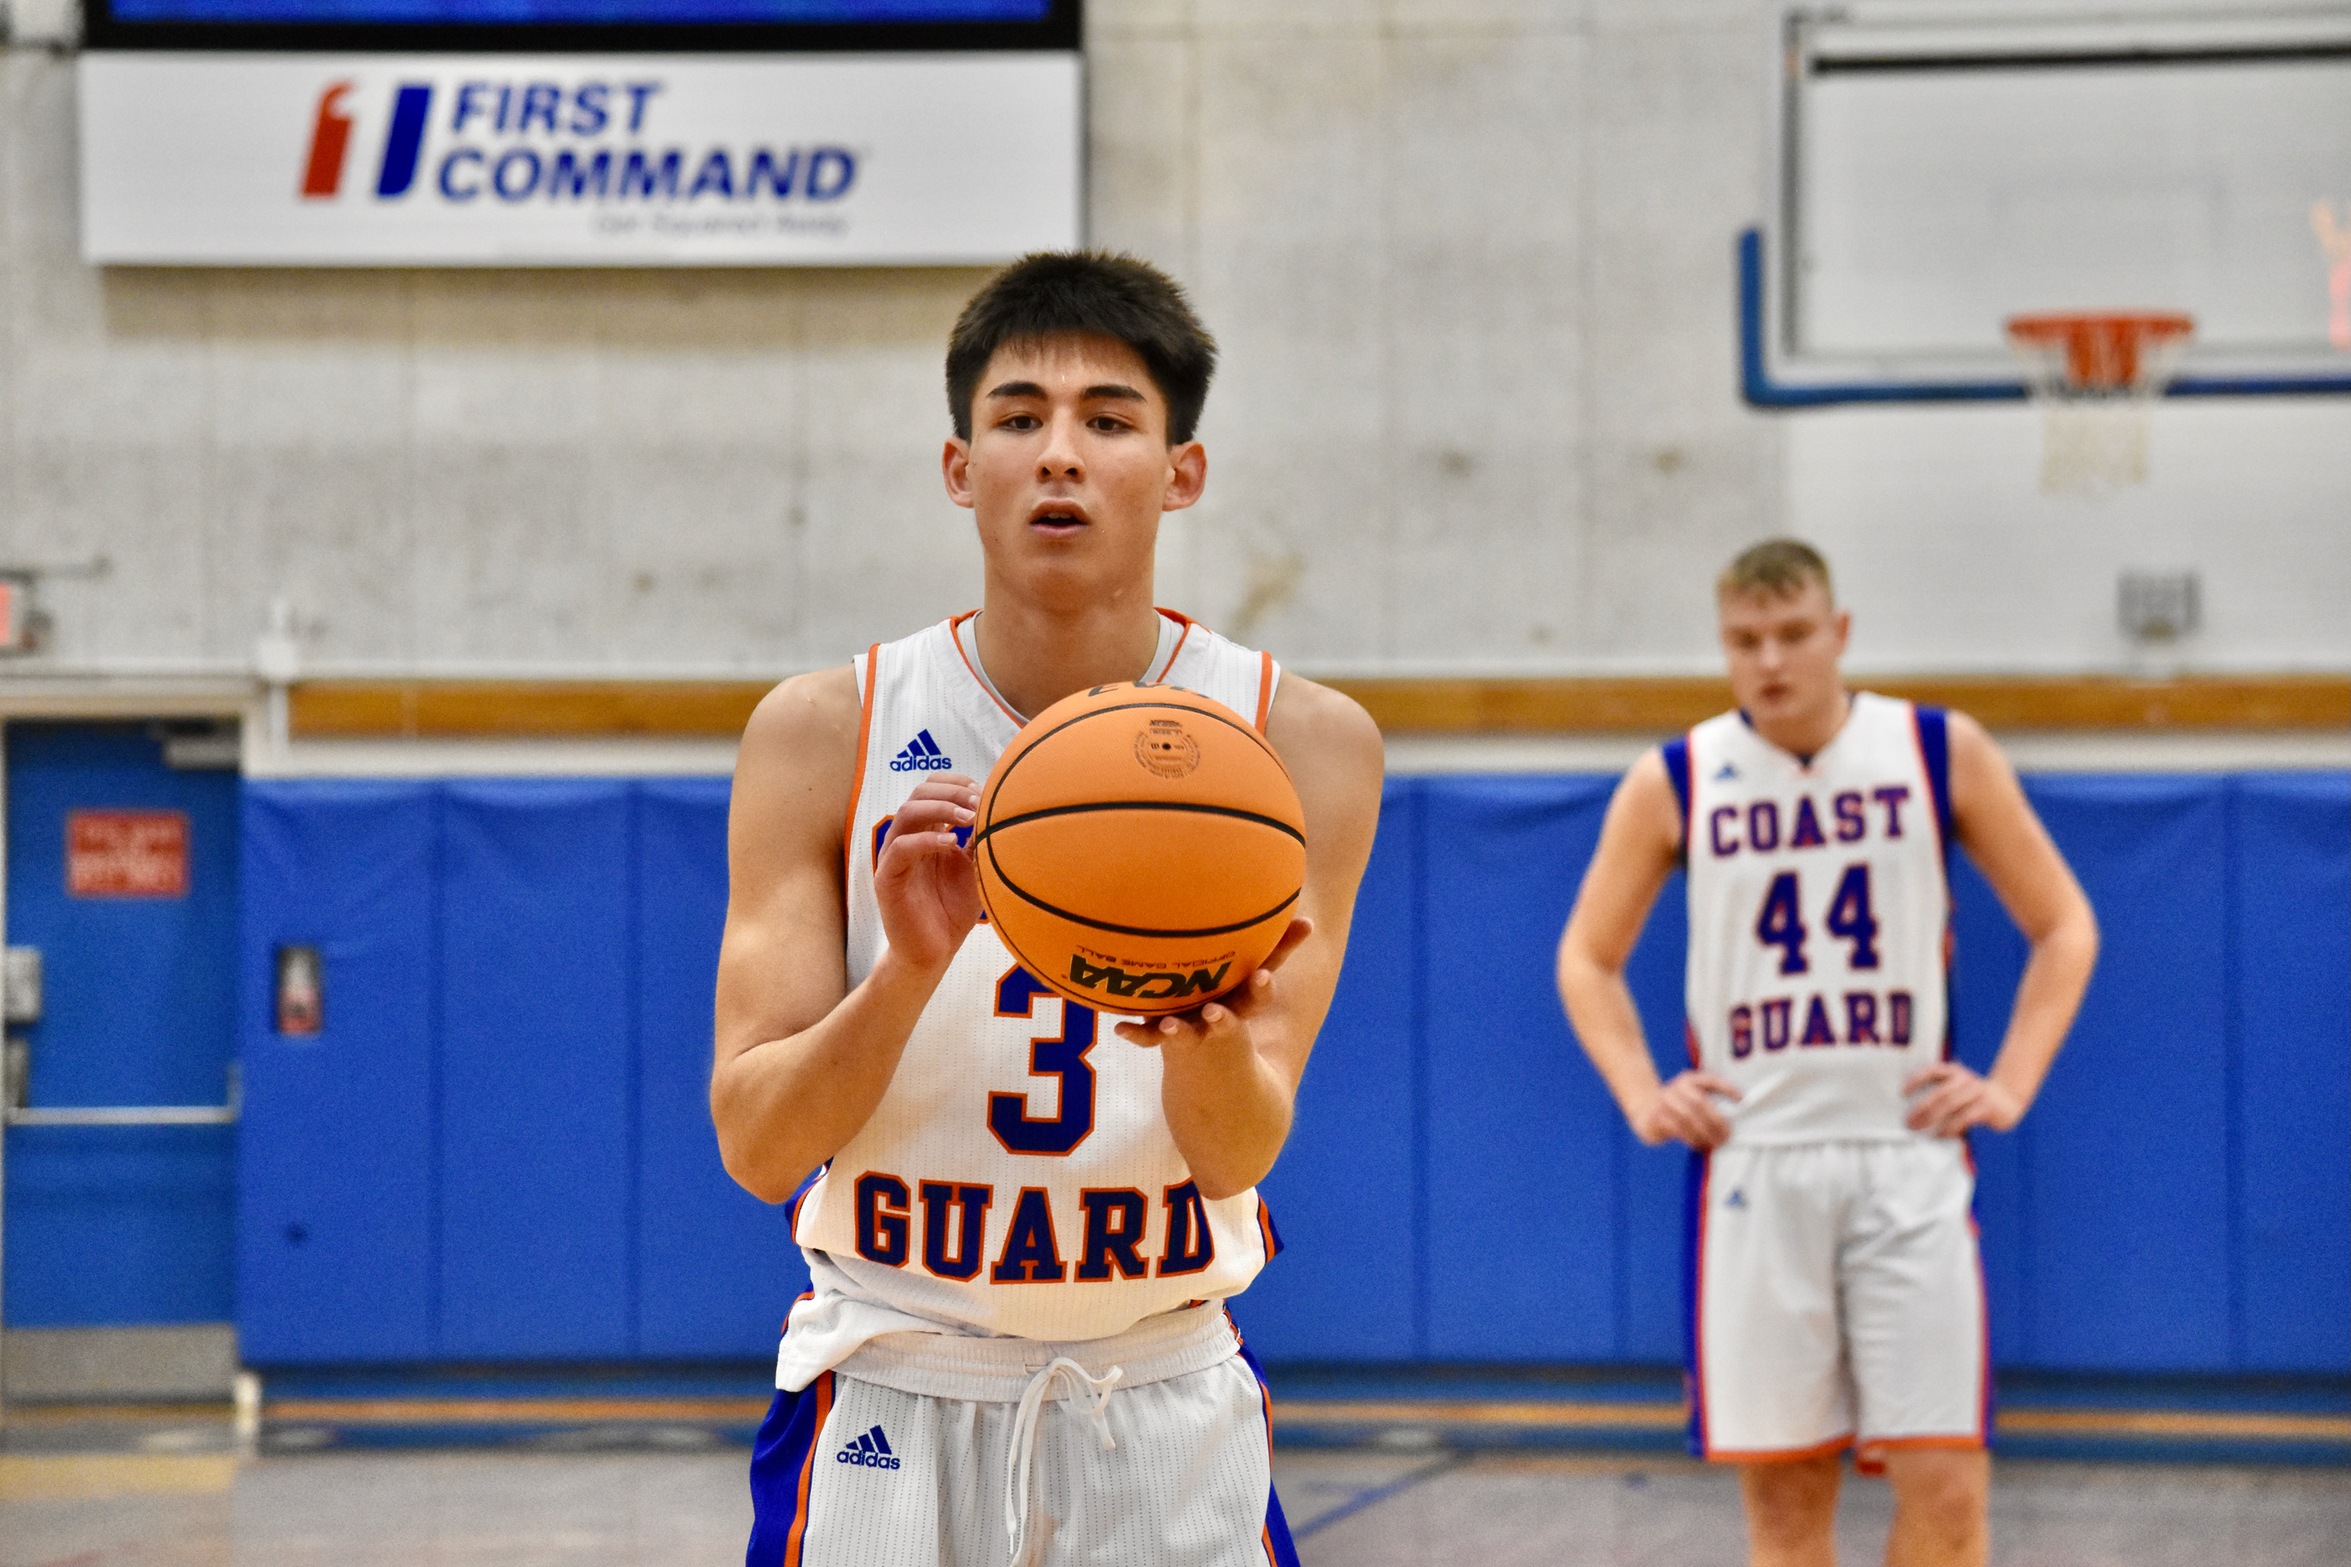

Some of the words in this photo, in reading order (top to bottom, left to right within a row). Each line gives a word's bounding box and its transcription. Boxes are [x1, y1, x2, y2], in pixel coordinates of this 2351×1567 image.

[451, 83, 661, 135] FIRST
[437, 146, 858, 201] COMMAND
[889, 755, 953, 772] adidas
[1710, 785, 1910, 858] COAST
[1756, 863, 1879, 977] 44
[1069, 953, 1233, 999] NCAA
[1076, 945, 1117, 963] BALL
[1121, 958, 1167, 969] GAME
[1171, 951, 1236, 969] OFFICIAL
[1728, 990, 1913, 1061] GUARD
[986, 962, 1099, 1157] 3
[854, 1170, 1215, 1285] GUARD
[836, 1450, 901, 1470] adidas
